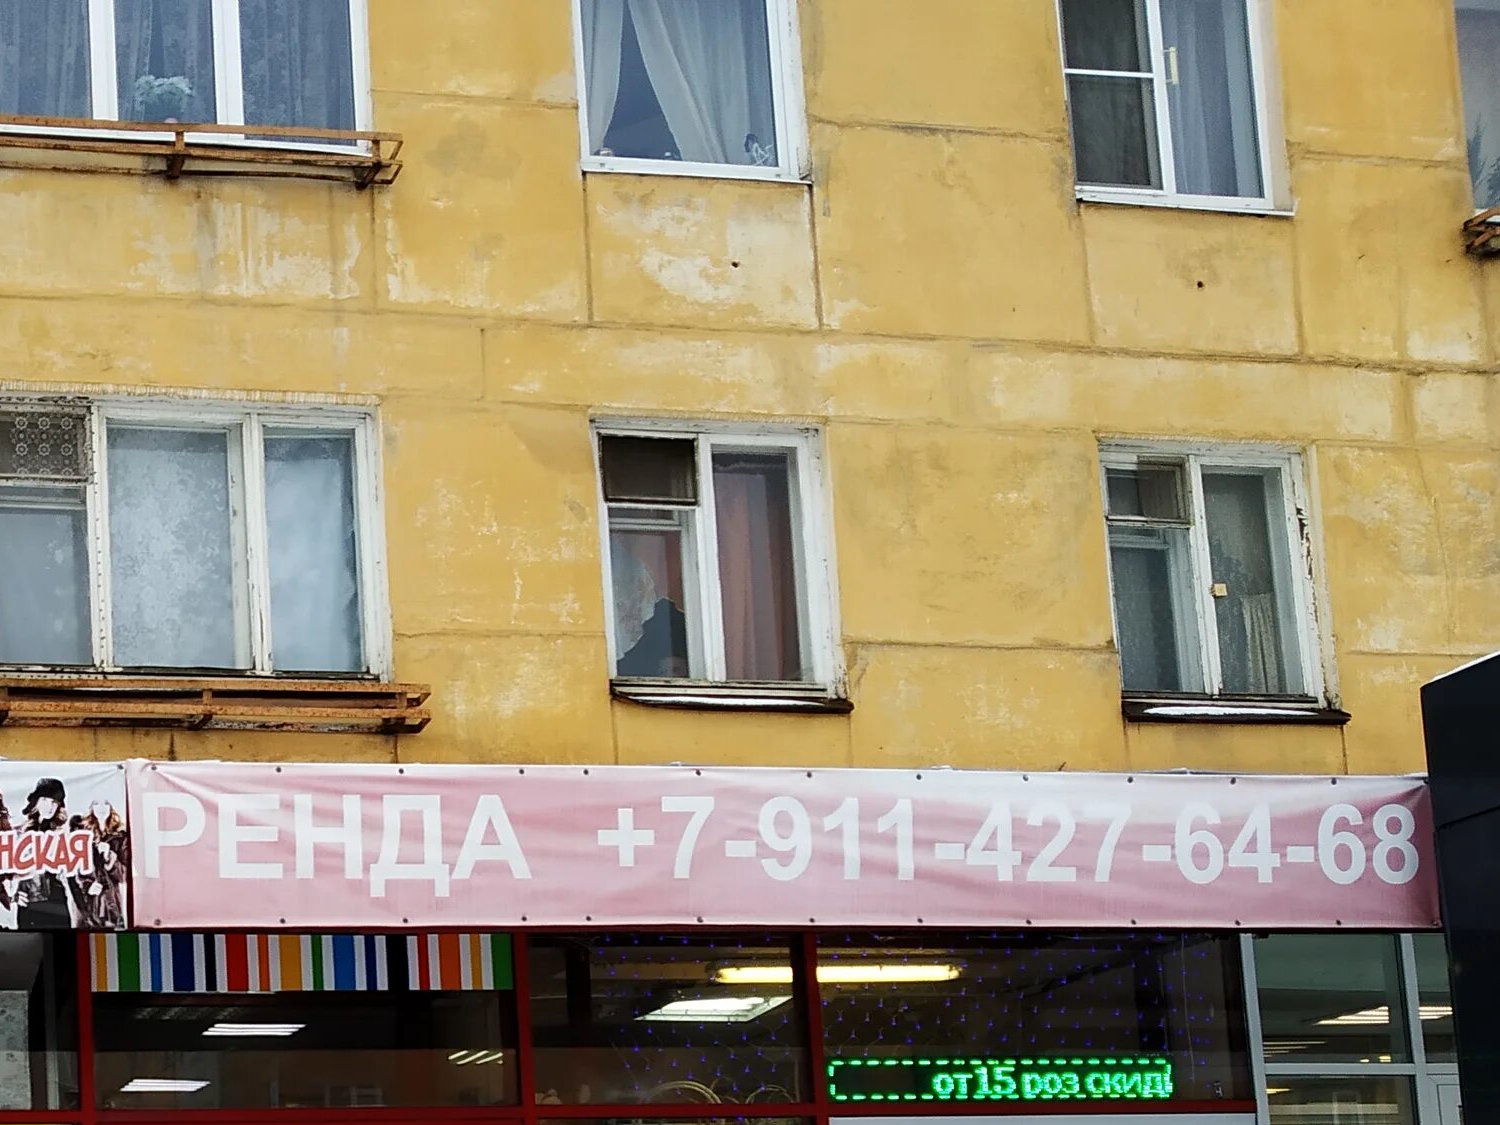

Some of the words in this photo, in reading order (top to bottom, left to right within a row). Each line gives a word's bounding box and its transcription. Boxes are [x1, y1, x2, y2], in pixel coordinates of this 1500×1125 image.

[133, 794, 531, 897] РЕНДА
[597, 796, 1420, 886] +7-911-427-64-68
[1021, 1072, 1080, 1098] роз
